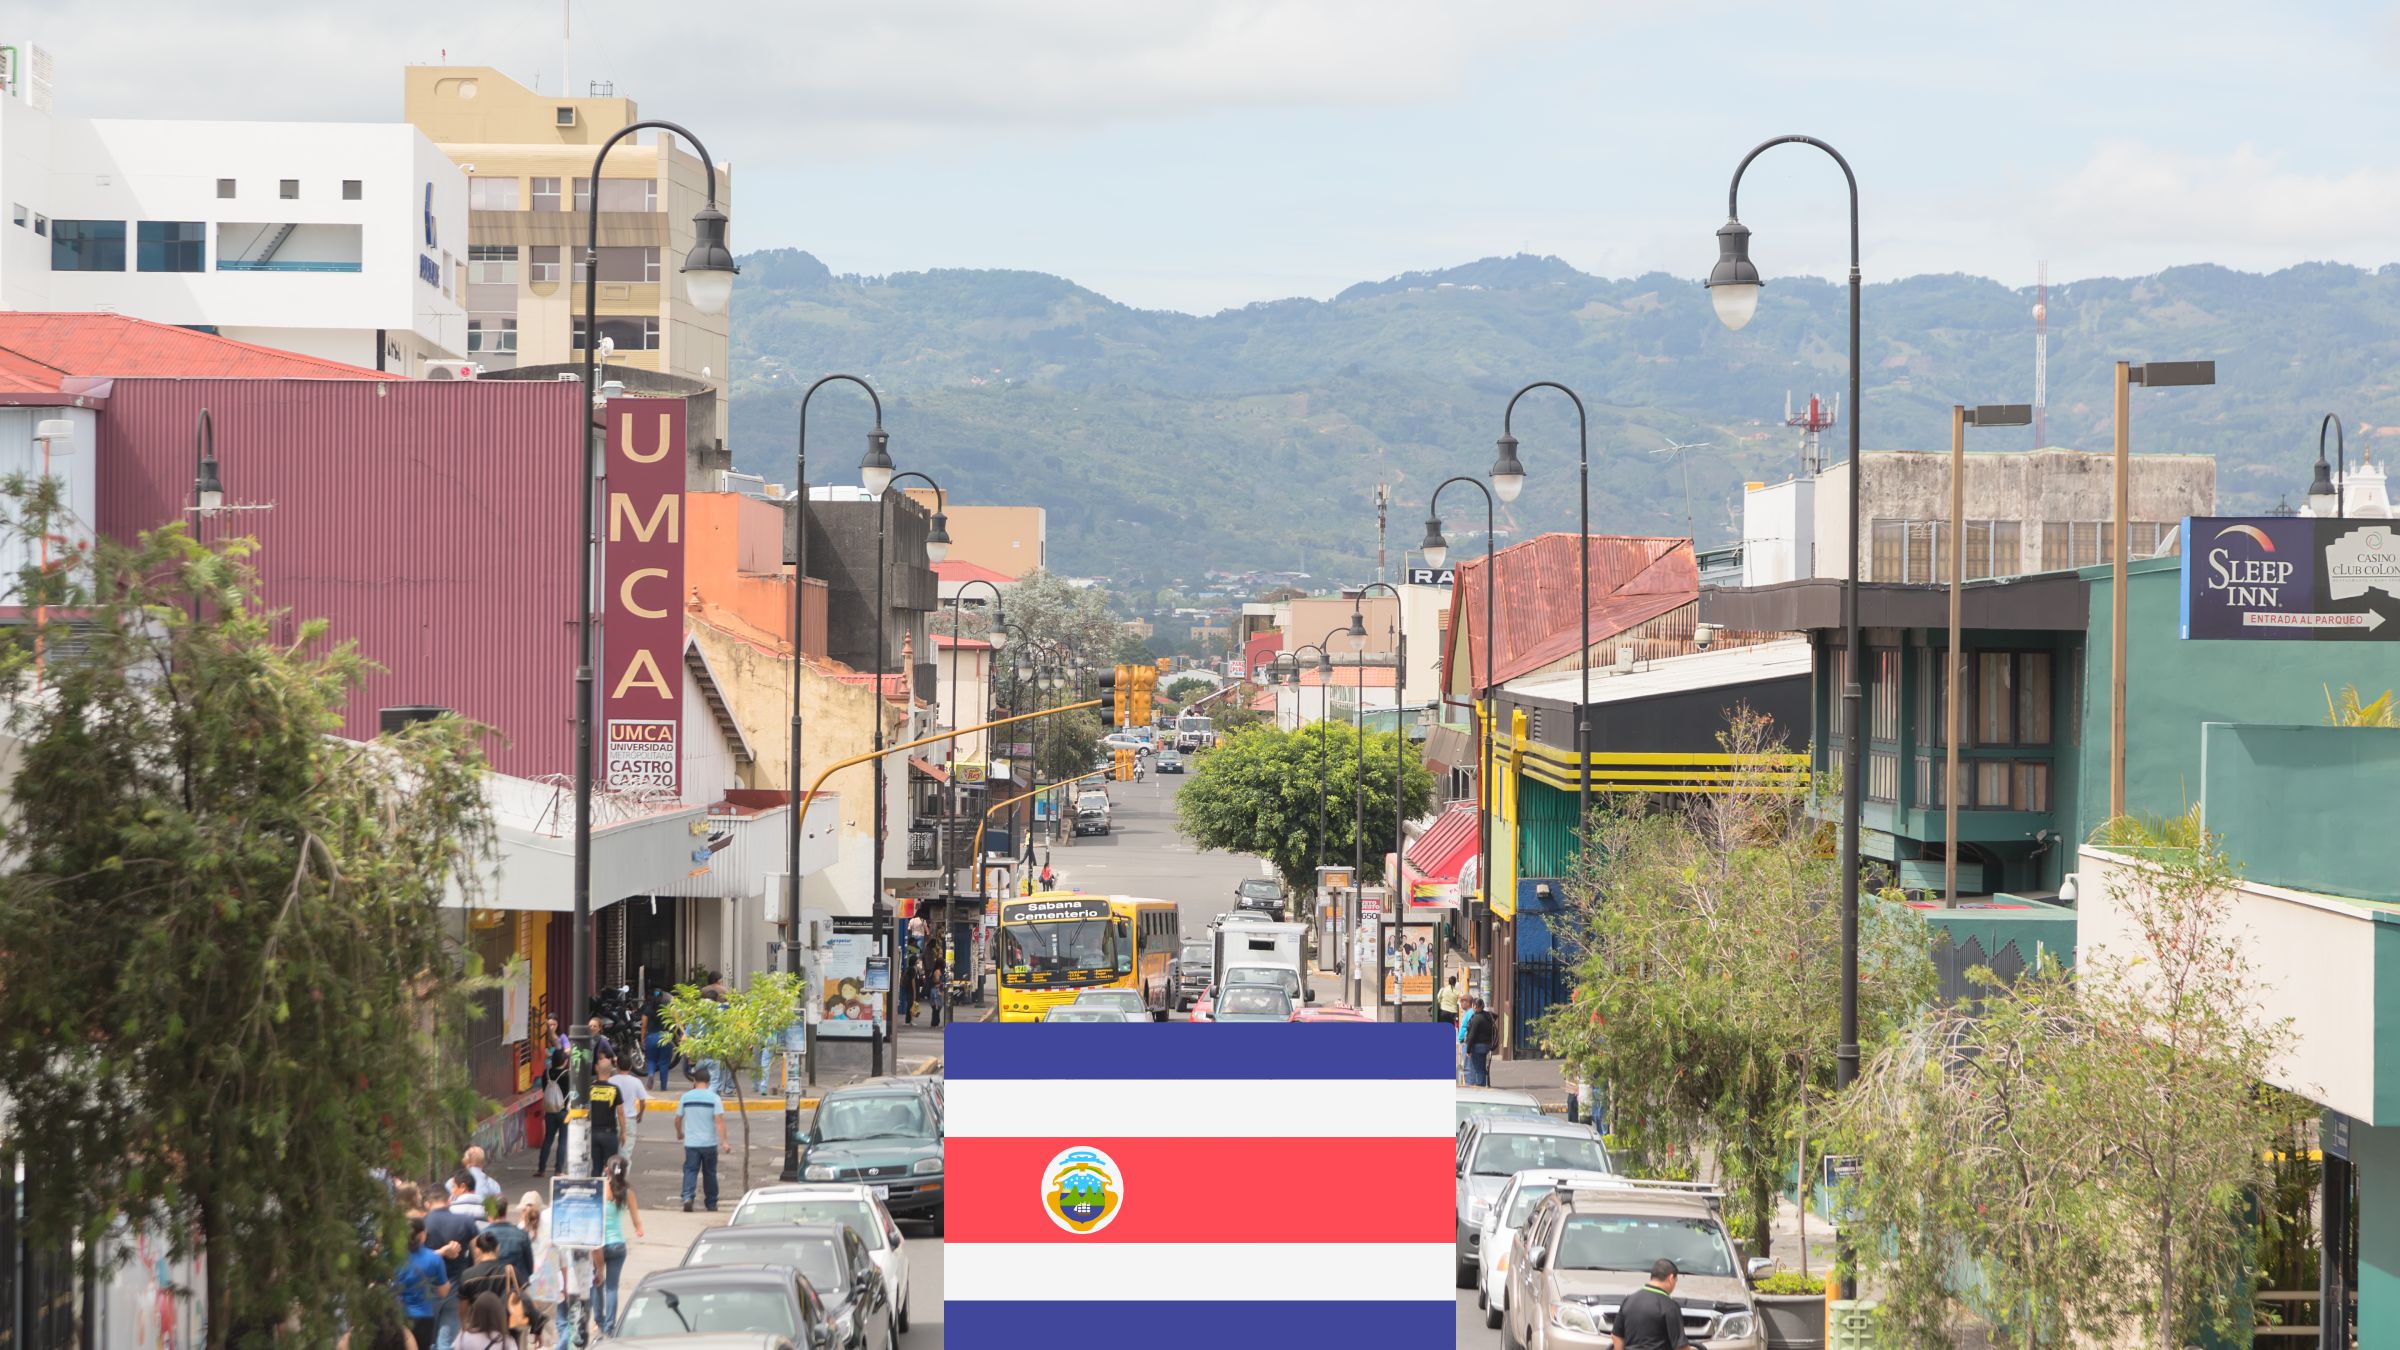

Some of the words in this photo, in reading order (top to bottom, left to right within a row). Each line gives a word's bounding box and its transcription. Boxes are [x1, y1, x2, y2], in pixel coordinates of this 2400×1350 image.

[610, 413, 679, 699] UMCA
[2357, 554, 2396, 562] CASINO
[2208, 548, 2293, 589] SLEEP
[2227, 587, 2279, 607] INN
[2250, 615, 2298, 624] ENTRADA
[2299, 615, 2313, 624] AL
[2315, 616, 2363, 625] PARQUEO
[612, 725, 672, 741] UMCA
[610, 743, 674, 752] UNIVERSIDAD
[609, 752, 674, 760] METROPOLITANA
[610, 760, 673, 773] CASTRO
[1028, 901, 1082, 911] Sabana
[1014, 910, 1098, 920] Cementerio
